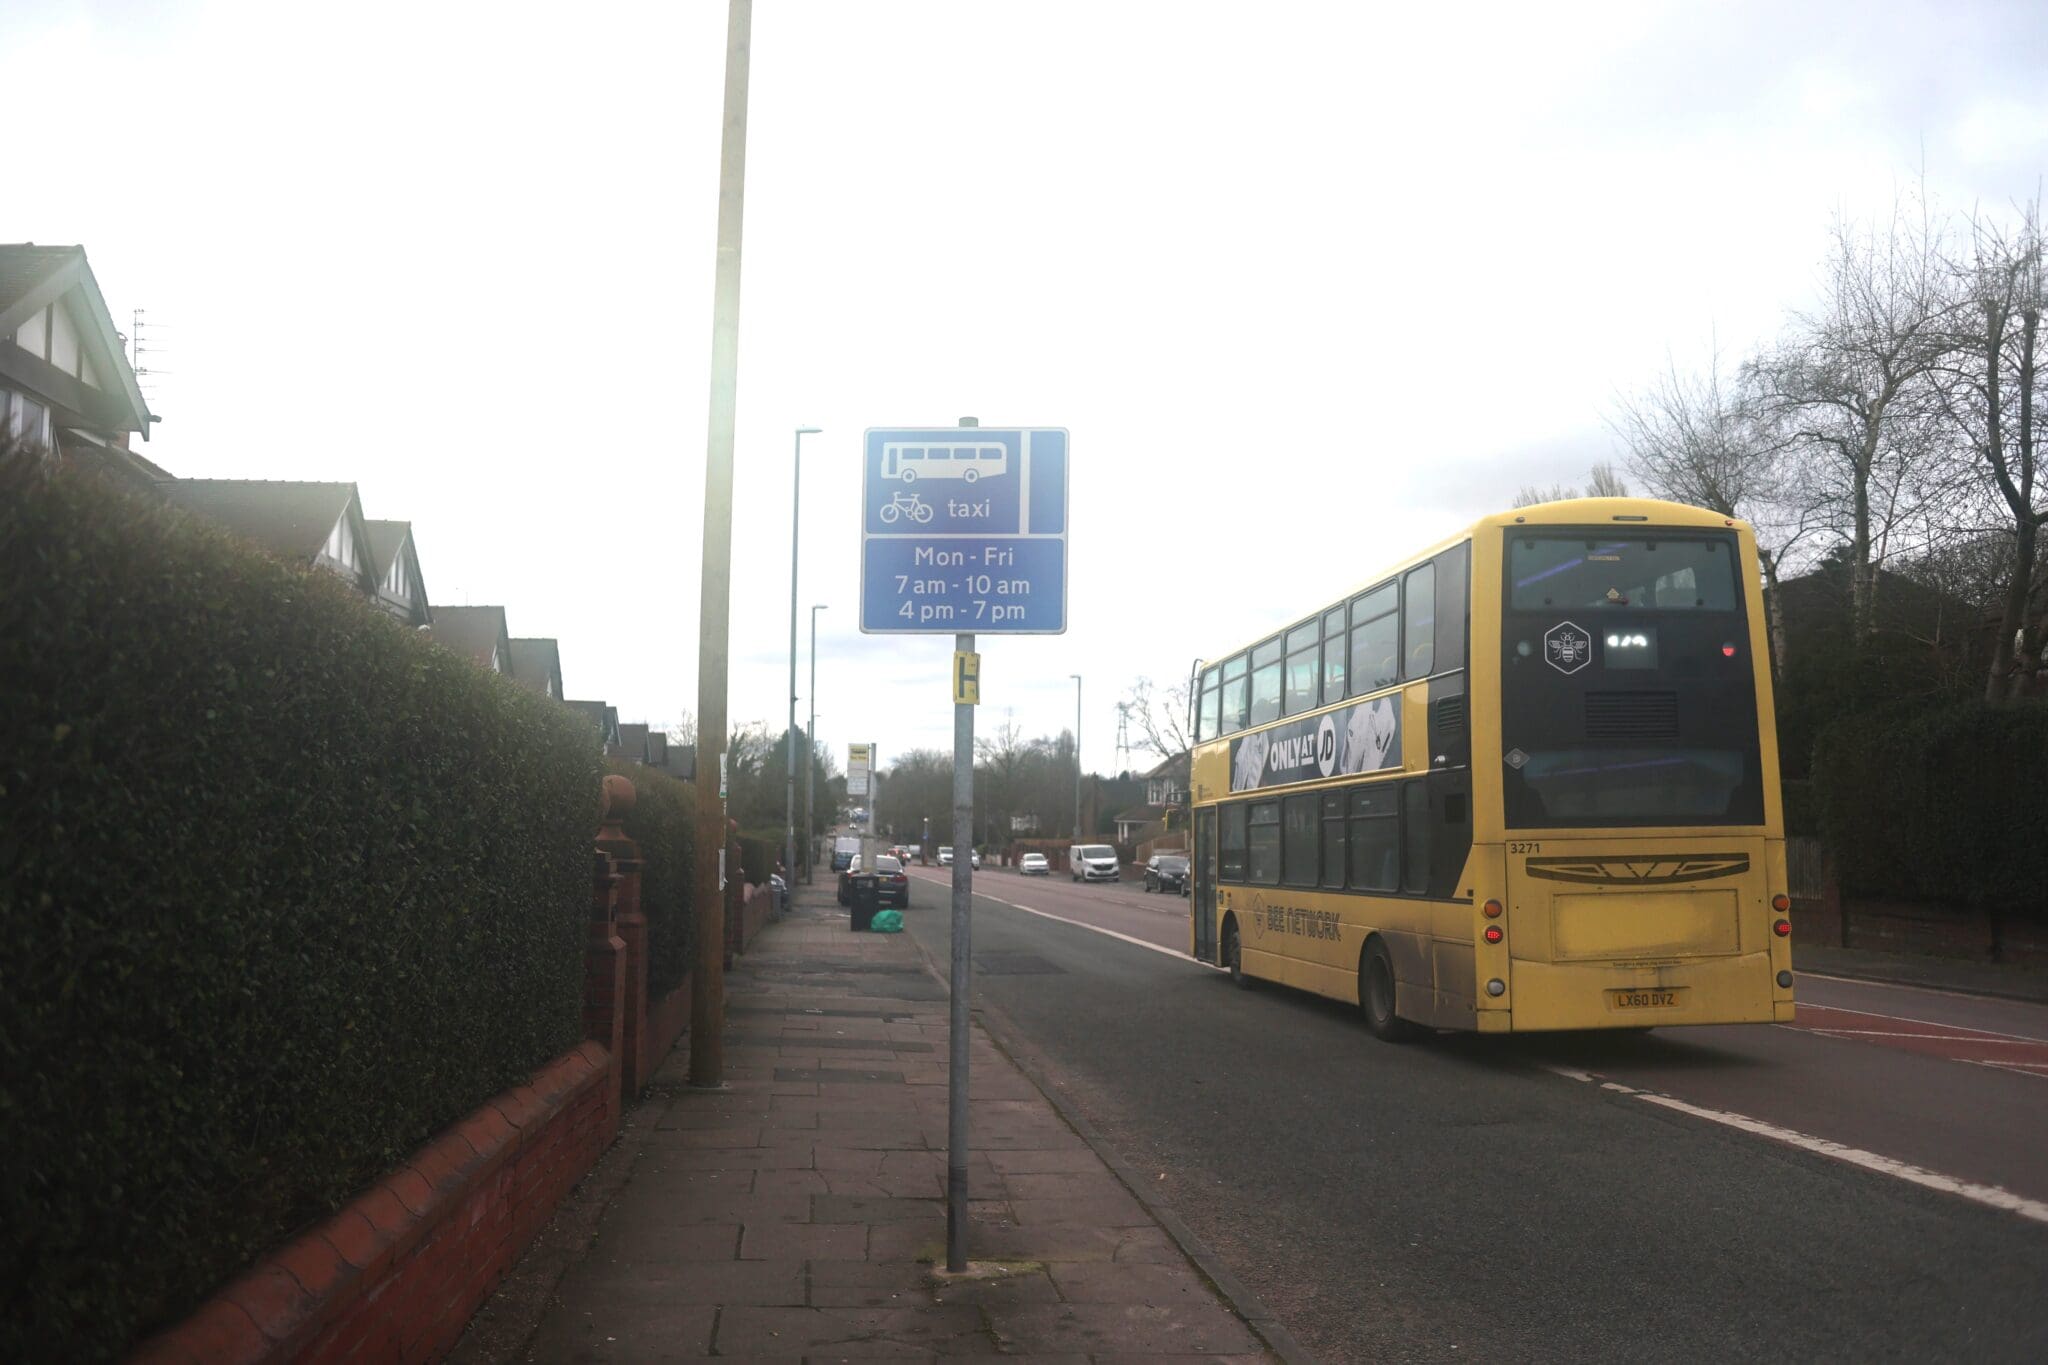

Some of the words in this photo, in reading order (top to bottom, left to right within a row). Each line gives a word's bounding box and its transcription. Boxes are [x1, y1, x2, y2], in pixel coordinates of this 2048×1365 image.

[948, 498, 990, 518] taxi
[915, 547, 964, 566] Mon
[984, 547, 1013, 566] Fri
[1270, 737, 1301, 772] ONLY
[1301, 733, 1314, 757] AT
[1319, 729, 1334, 762] JD
[1510, 843, 1541, 854] 3271
[1267, 905, 1285, 933] BEE
[1287, 907, 1342, 941] NETWORK
[1618, 993, 1649, 1007] LX60
